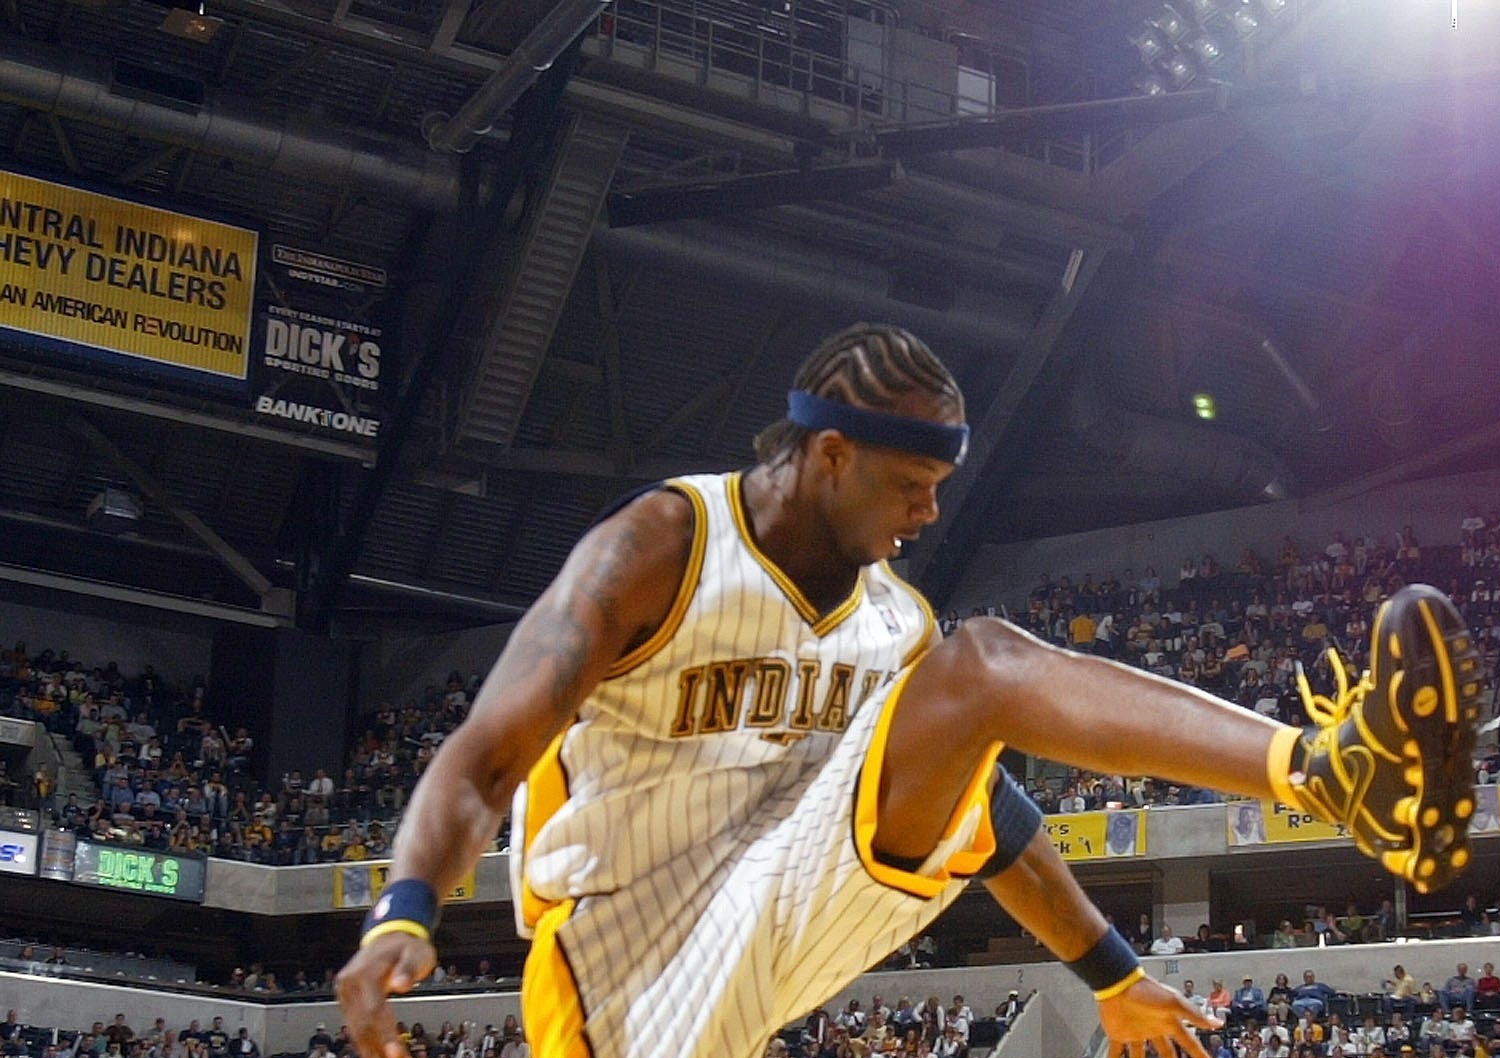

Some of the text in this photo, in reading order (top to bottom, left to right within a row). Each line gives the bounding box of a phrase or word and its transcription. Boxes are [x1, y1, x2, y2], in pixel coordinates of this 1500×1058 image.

[86, 253, 226, 310] DEALERS
[115, 225, 243, 282] INDIANA
[1, 284, 243, 354] AN AMERICAN REVOLUTION
[265, 318, 380, 381] DICK'S
